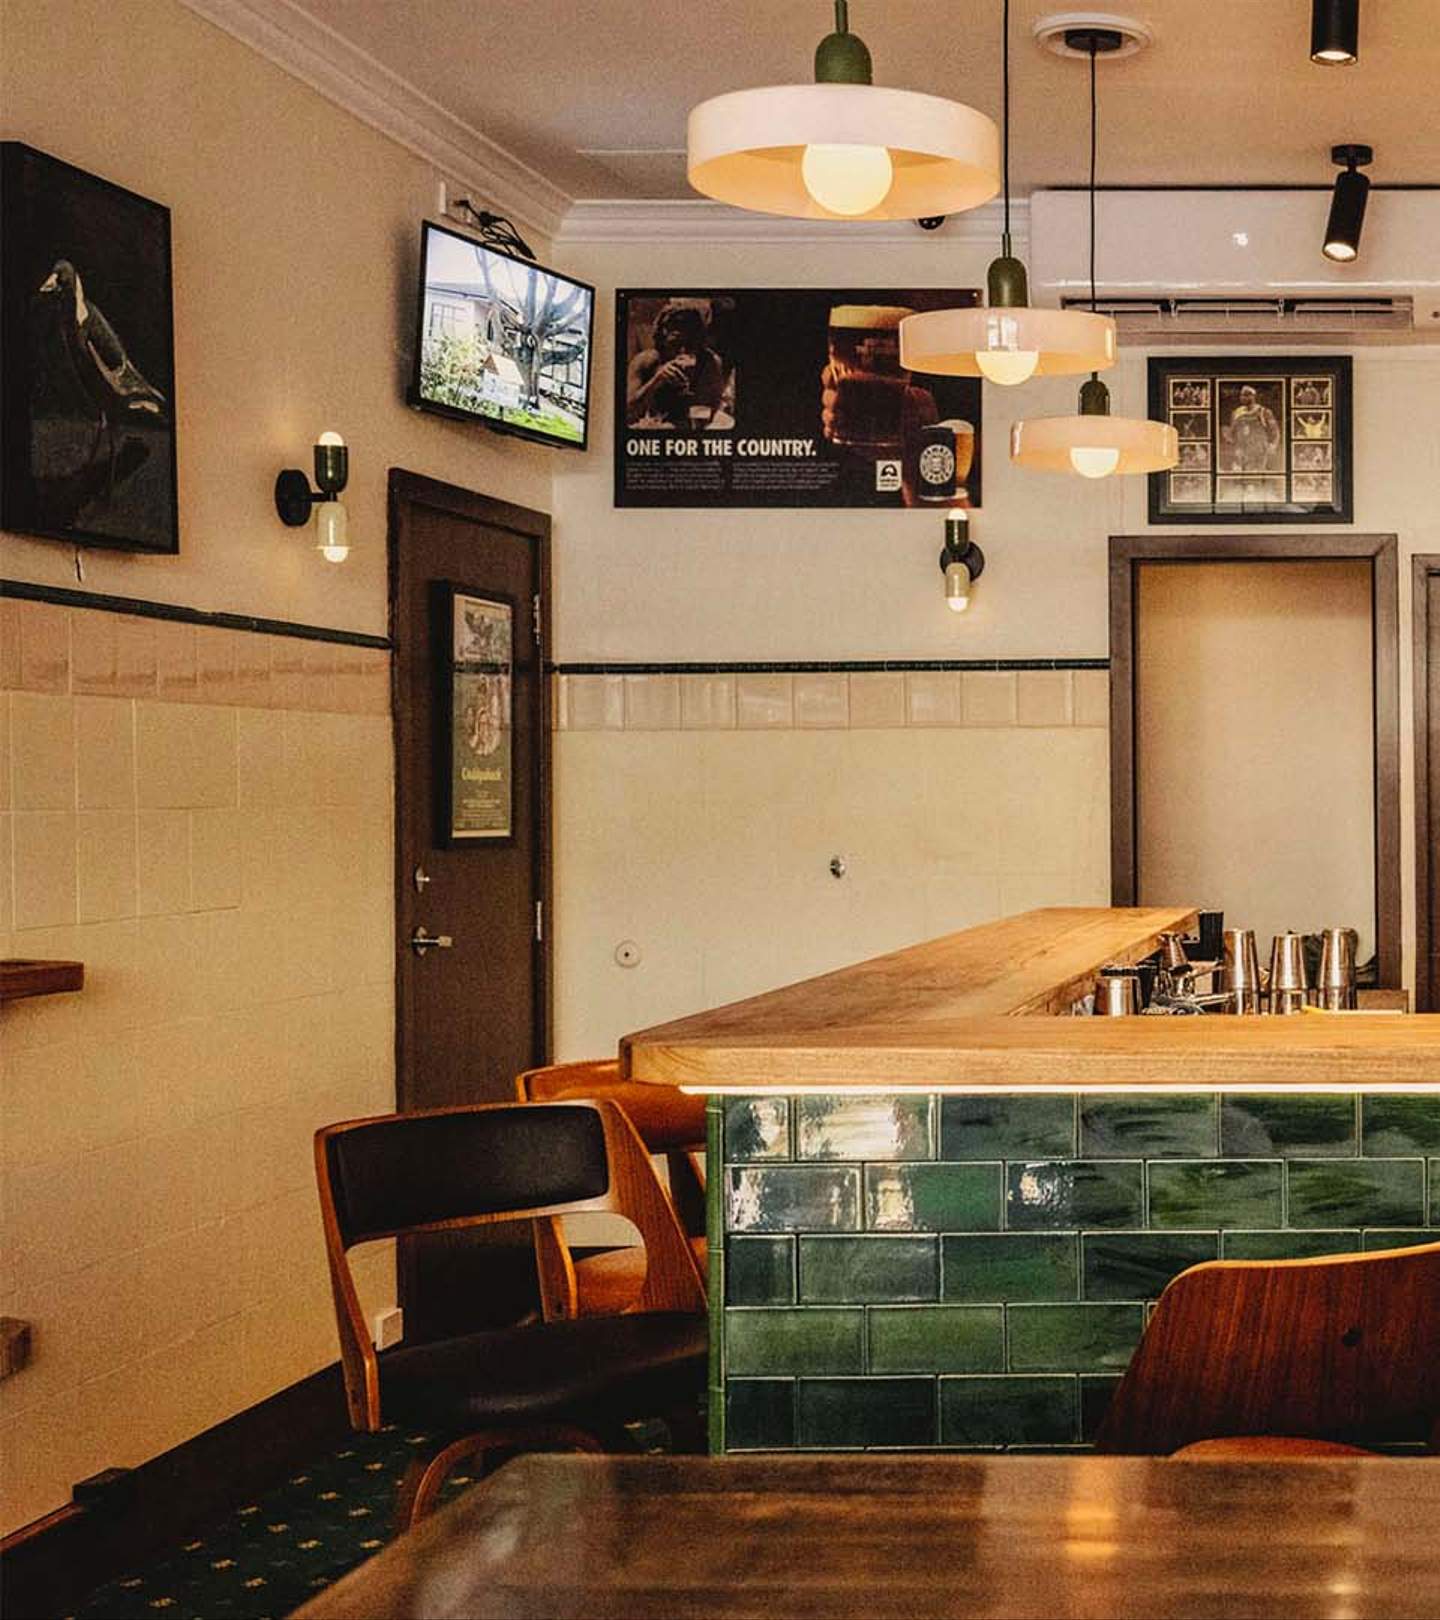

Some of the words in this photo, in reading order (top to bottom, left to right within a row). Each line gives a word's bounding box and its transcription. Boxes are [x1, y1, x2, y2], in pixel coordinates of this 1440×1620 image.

[627, 439, 660, 456] ONE
[666, 440, 698, 456] FOR
[701, 440, 732, 456] THE
[737, 439, 817, 456] COUNTRY.
